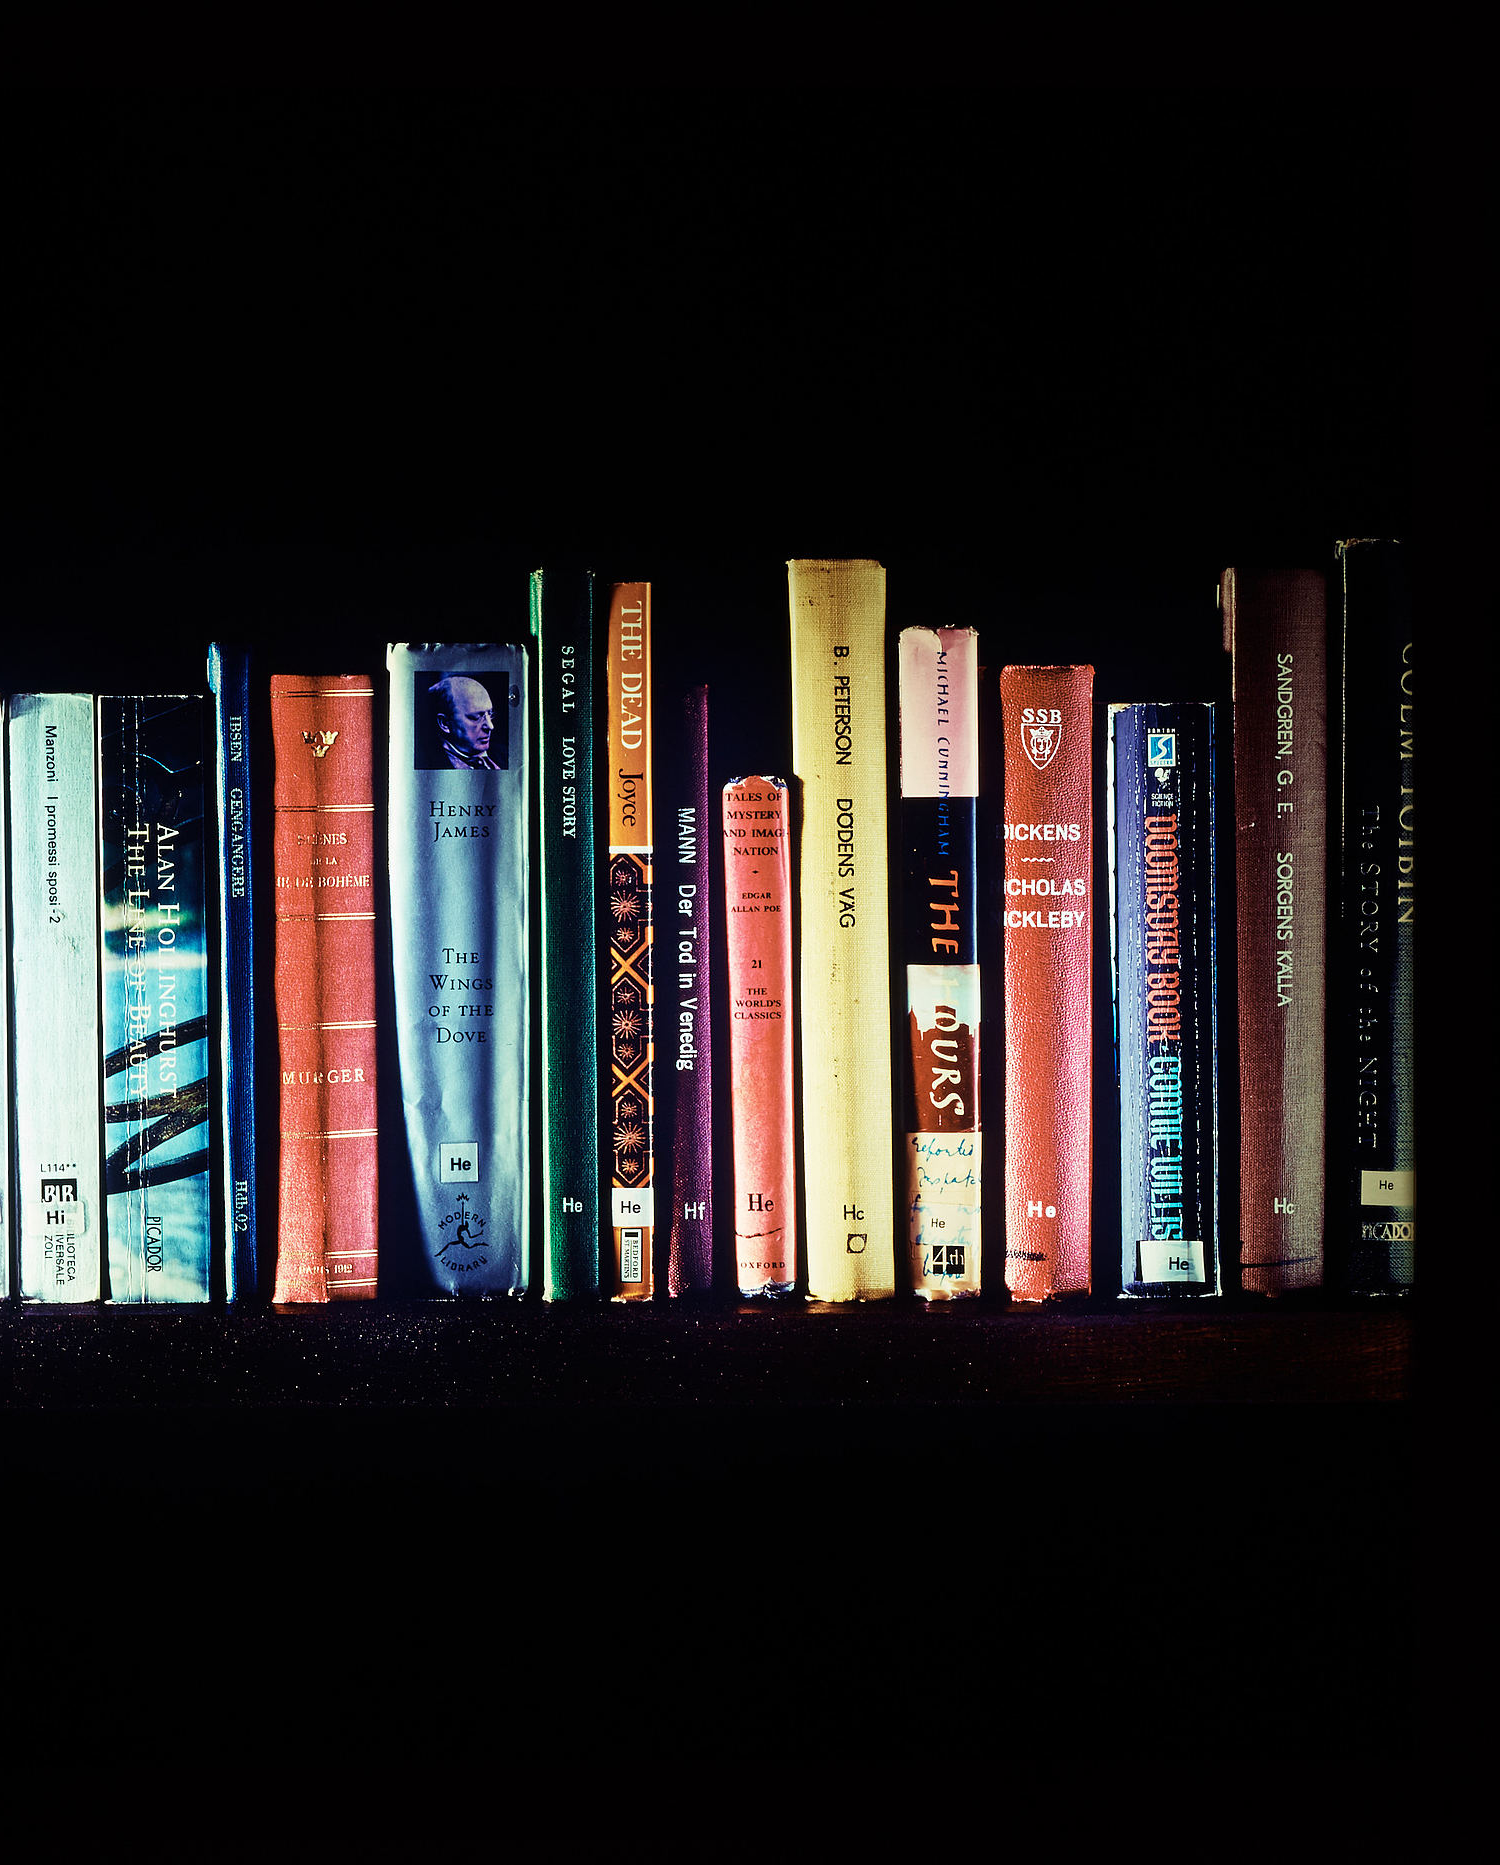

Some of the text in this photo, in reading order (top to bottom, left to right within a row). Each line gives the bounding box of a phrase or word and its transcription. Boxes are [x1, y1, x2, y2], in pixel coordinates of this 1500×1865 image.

[617, 600, 644, 828] THE DEAD Joyce
[1021, 707, 1062, 724] SSB
[229, 715, 242, 763] IBSEN
[561, 645, 577, 839] SEGAL LOVE STORY
[936, 650, 950, 857] MICHAEL CUNNINGHAM
[833, 644, 857, 929] B. PETERSON DÖDENS VÄG
[725, 792, 783, 802] TALES OF
[44, 724, 61, 907] Manzoni promessi sposi
[429, 801, 497, 818] HENRY
[726, 810, 782, 820] MYSTERY
[433, 822, 490, 842] JAMES
[723, 828, 747, 838] AND
[1274, 652, 1294, 1008] SANDGREN, G. E. SORGENS KÄLLA
[126, 823, 151, 878] THE
[733, 846, 779, 856] NATION
[325, 856, 339, 865] LA
[741, 892, 772, 900] EDGAR
[1144, 813, 1180, 965] DOOMSDAY
[730, 905, 781, 913] ALLAN POE
[928, 870, 960, 954] THE
[675, 806, 699, 1071] MANN Der Tod in Venedig
[156, 822, 181, 1099] ALAN HOLLINGHURST
[441, 948, 480, 964] THE
[750, 959, 763, 969] 21
[428, 974, 494, 991] WINGS
[745, 987, 768, 996] THE
[428, 1004, 494, 1018] OF THE
[735, 999, 782, 1008] WORLD'S
[1146, 971, 1182, 1044] BOOK
[733, 1011, 782, 1020] CLASSICS
[435, 1027, 488, 1044] DOVE
[282, 1067, 367, 1085] MURGER
[450, 1157, 472, 1171] He
[1378, 1180, 1395, 1191] He
[562, 1197, 583, 1213] He
[747, 1192, 775, 1212] He
[1150, 1155, 1184, 1240] WILLIS
[1273, 1197, 1295, 1215] Hc
[619, 1201, 641, 1214] He
[683, 1201, 707, 1220] Hf
[843, 1204, 866, 1221] Hc
[1026, 1200, 1057, 1219] He
[46, 1209, 65, 1225] Hi
[438, 1210, 487, 1231] MODERN
[930, 1218, 946, 1228] He
[146, 1216, 164, 1273] PICADOR
[440, 1255, 488, 1272] LIBRARY
[740, 1261, 786, 1270] OXFORD
[932, 1246, 965, 1275] 4th
[1168, 1256, 1190, 1271] He
